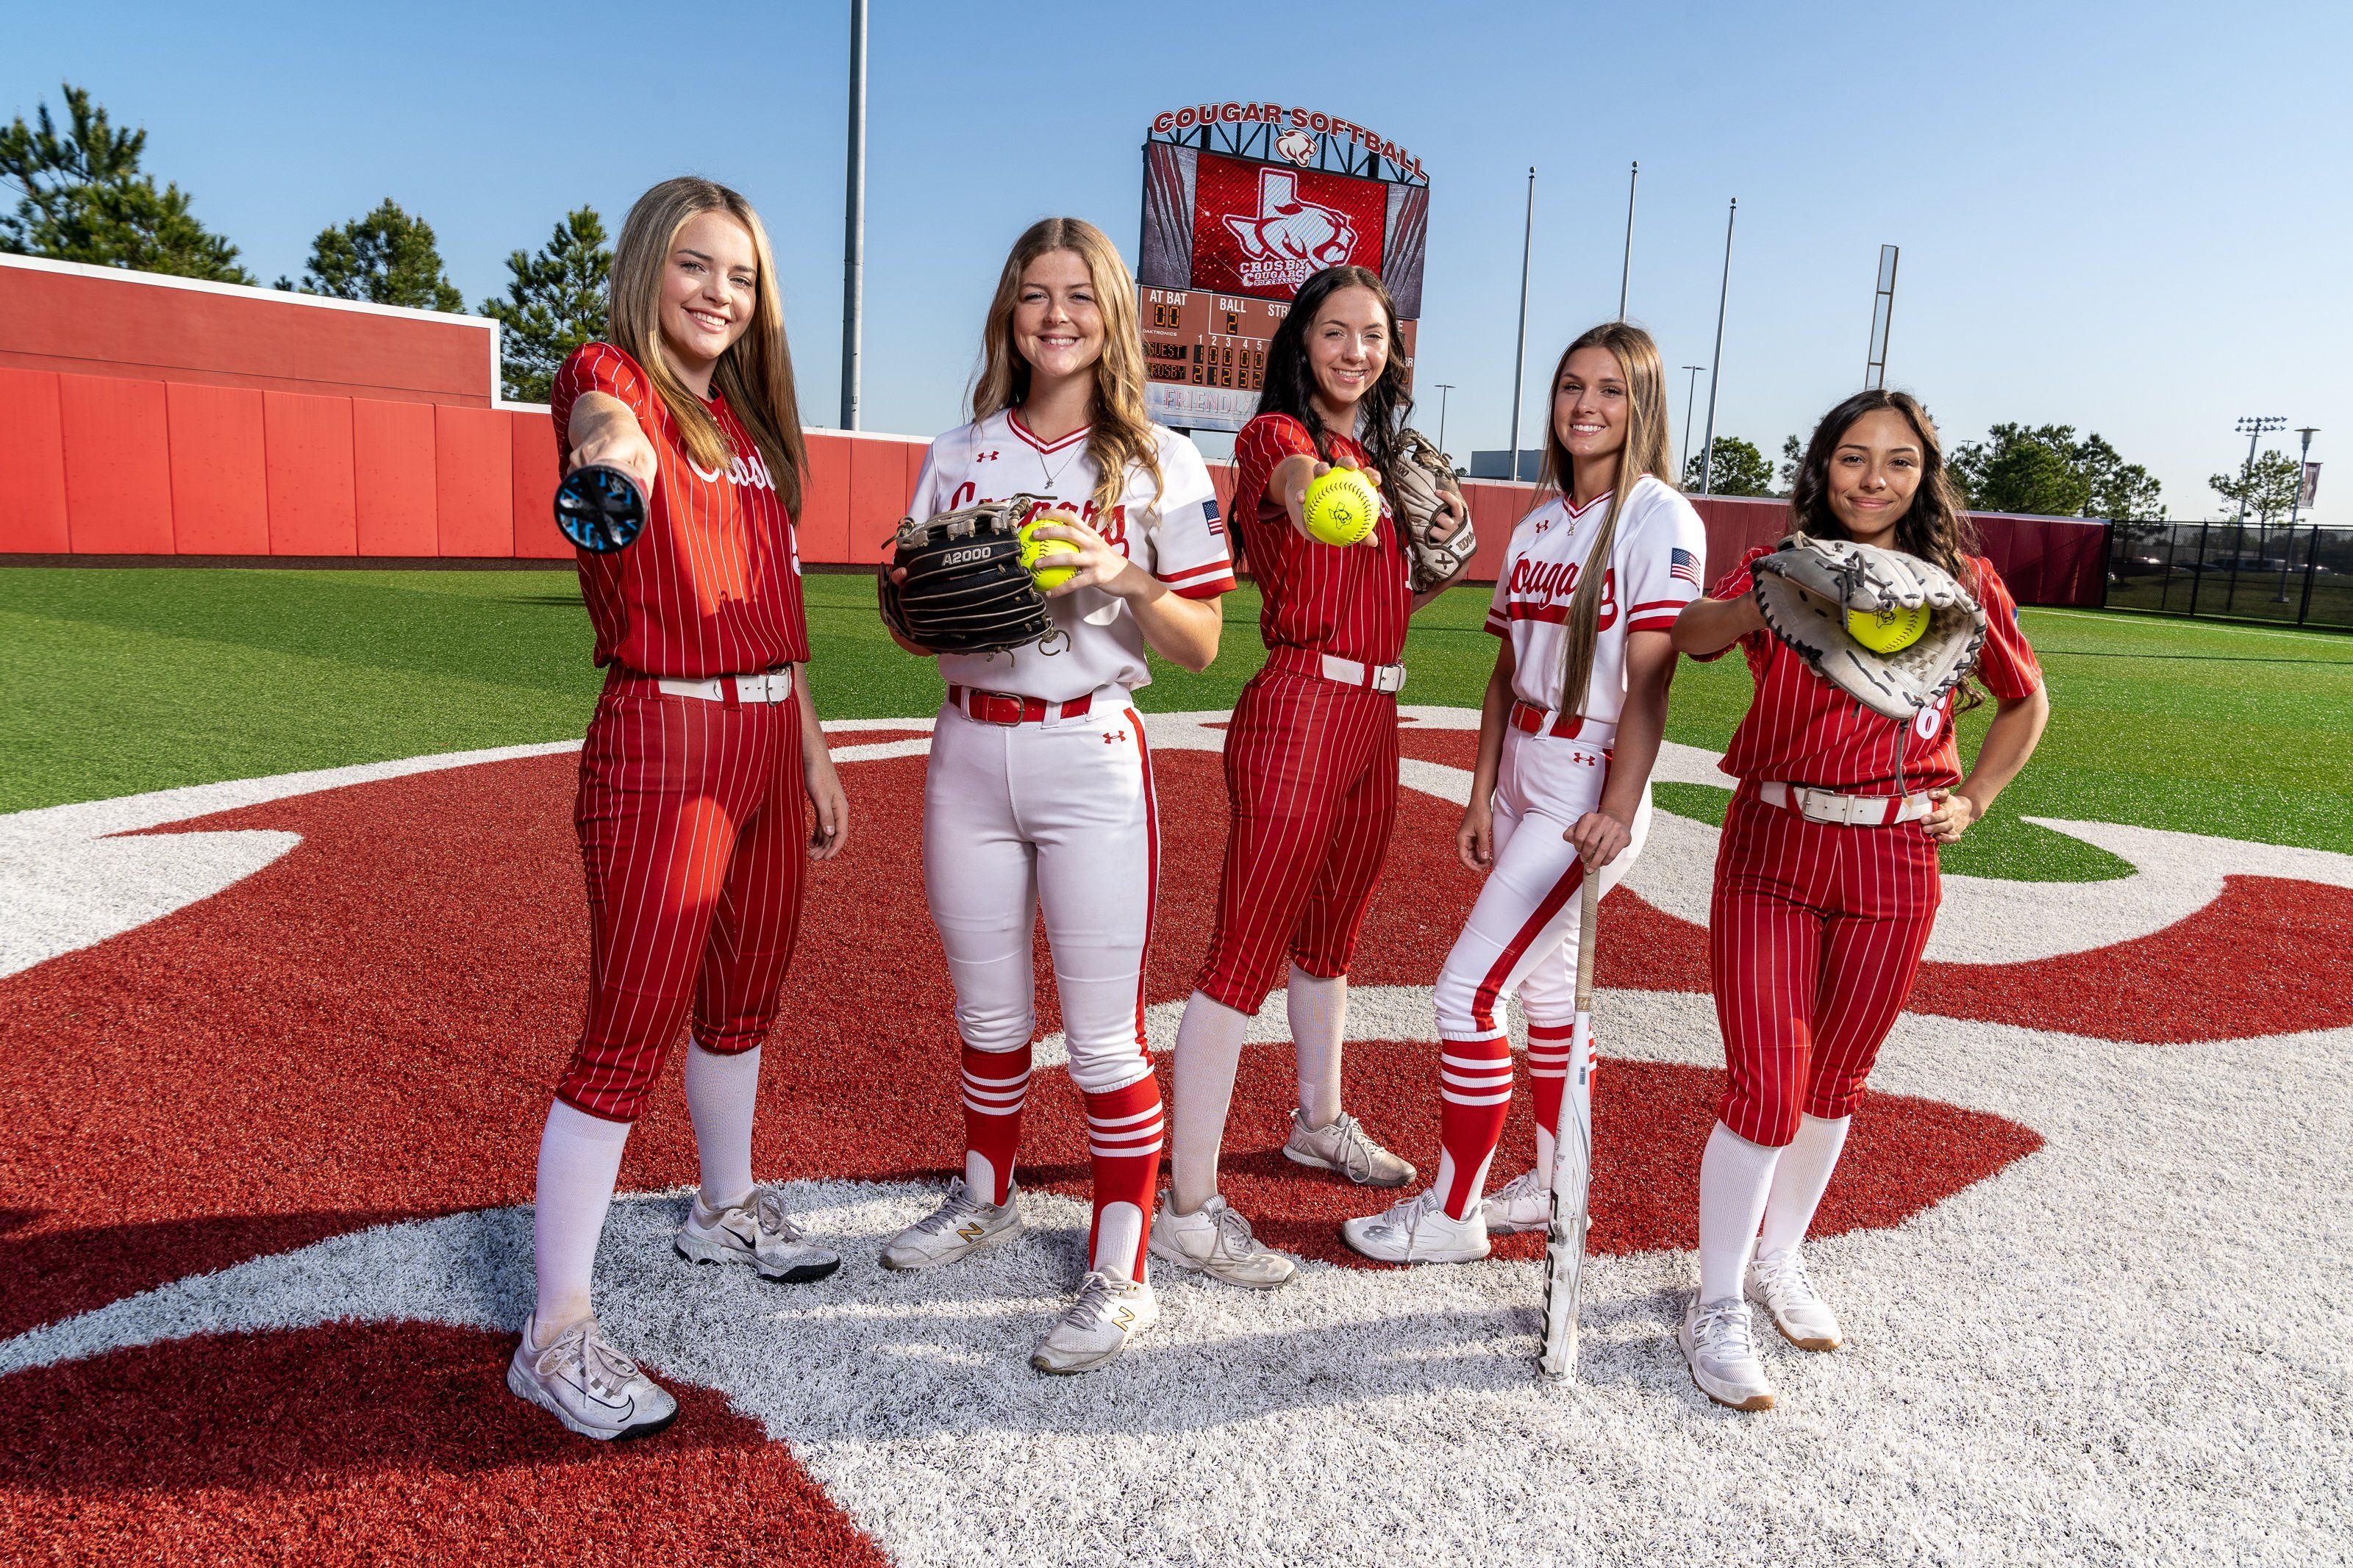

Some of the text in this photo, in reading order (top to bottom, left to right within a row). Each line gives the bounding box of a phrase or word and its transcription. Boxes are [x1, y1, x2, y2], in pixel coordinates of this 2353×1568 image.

[1151, 101, 1429, 184] COUGAR SOFTBALL
[1240, 259, 1309, 273] CROSBY
[1243, 269, 1305, 287] COUGARS
[1149, 290, 1188, 306] AT BAT
[1219, 298, 1247, 313] BALL
[1154, 304, 1180, 327] 00
[1227, 313, 1238, 333] 2
[1143, 329, 1177, 337] DAKTRONICS
[1198, 334, 1263, 350] 1 2 3 4 5
[1147, 343, 1182, 359] GUEST
[1209, 347, 1218, 363] 0
[1224, 348, 1232, 365] 0
[1240, 350, 1249, 367] 0
[1254, 352, 1263, 368] 0
[1147, 365, 1186, 379] ROSBY
[1193, 365, 1202, 382] 2
[1222, 369, 1232, 385] 2
[1239, 370, 1248, 387] 3
[1253, 372, 1263, 388] 2
[1164, 388, 1254, 415] FRIENDLY
[942, 546, 991, 566] A2000
